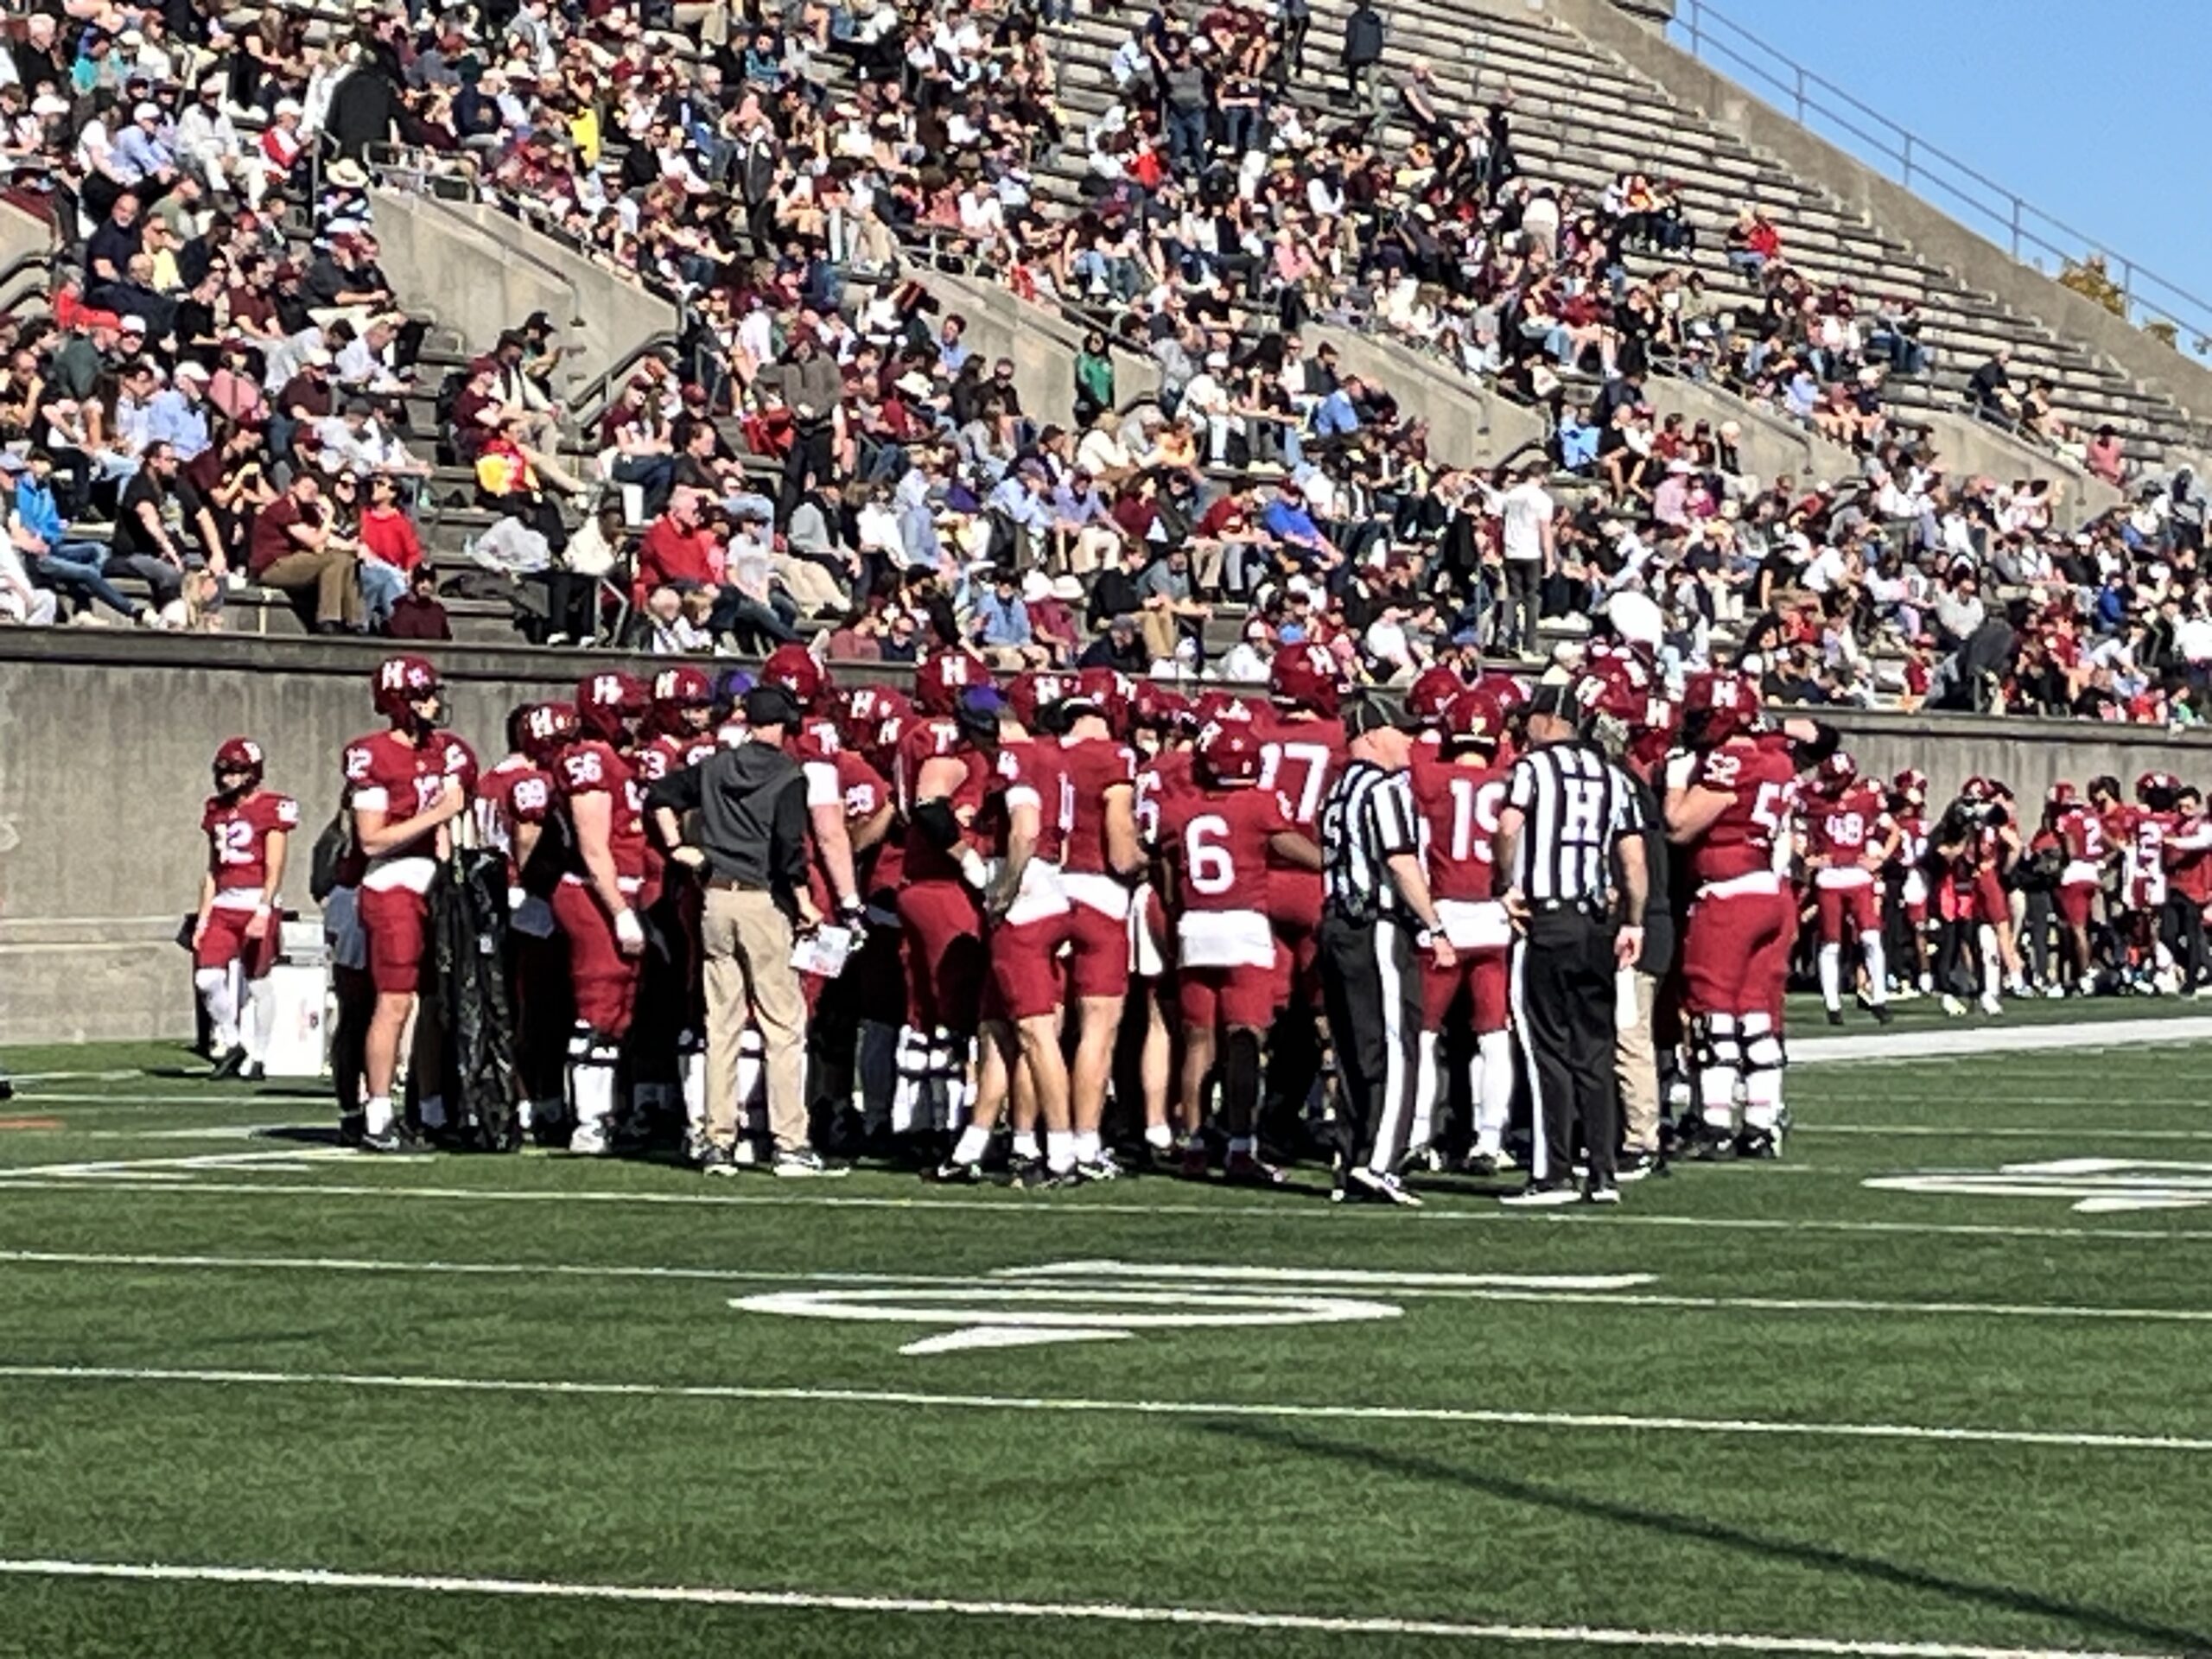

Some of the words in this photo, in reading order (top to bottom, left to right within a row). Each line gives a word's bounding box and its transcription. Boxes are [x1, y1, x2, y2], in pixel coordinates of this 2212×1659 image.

[383, 659, 406, 690] H
[941, 655, 968, 685] H
[593, 675, 624, 705] H
[851, 690, 876, 719] H
[1712, 680, 1738, 708] H
[530, 707, 555, 739] H
[1644, 697, 1671, 729] H
[346, 747, 372, 779] 12
[563, 751, 603, 786] 56
[1256, 741, 1331, 823] 17
[1560, 778, 1605, 842] H
[214, 820, 255, 865] 12
[1185, 814, 1236, 895] 6
